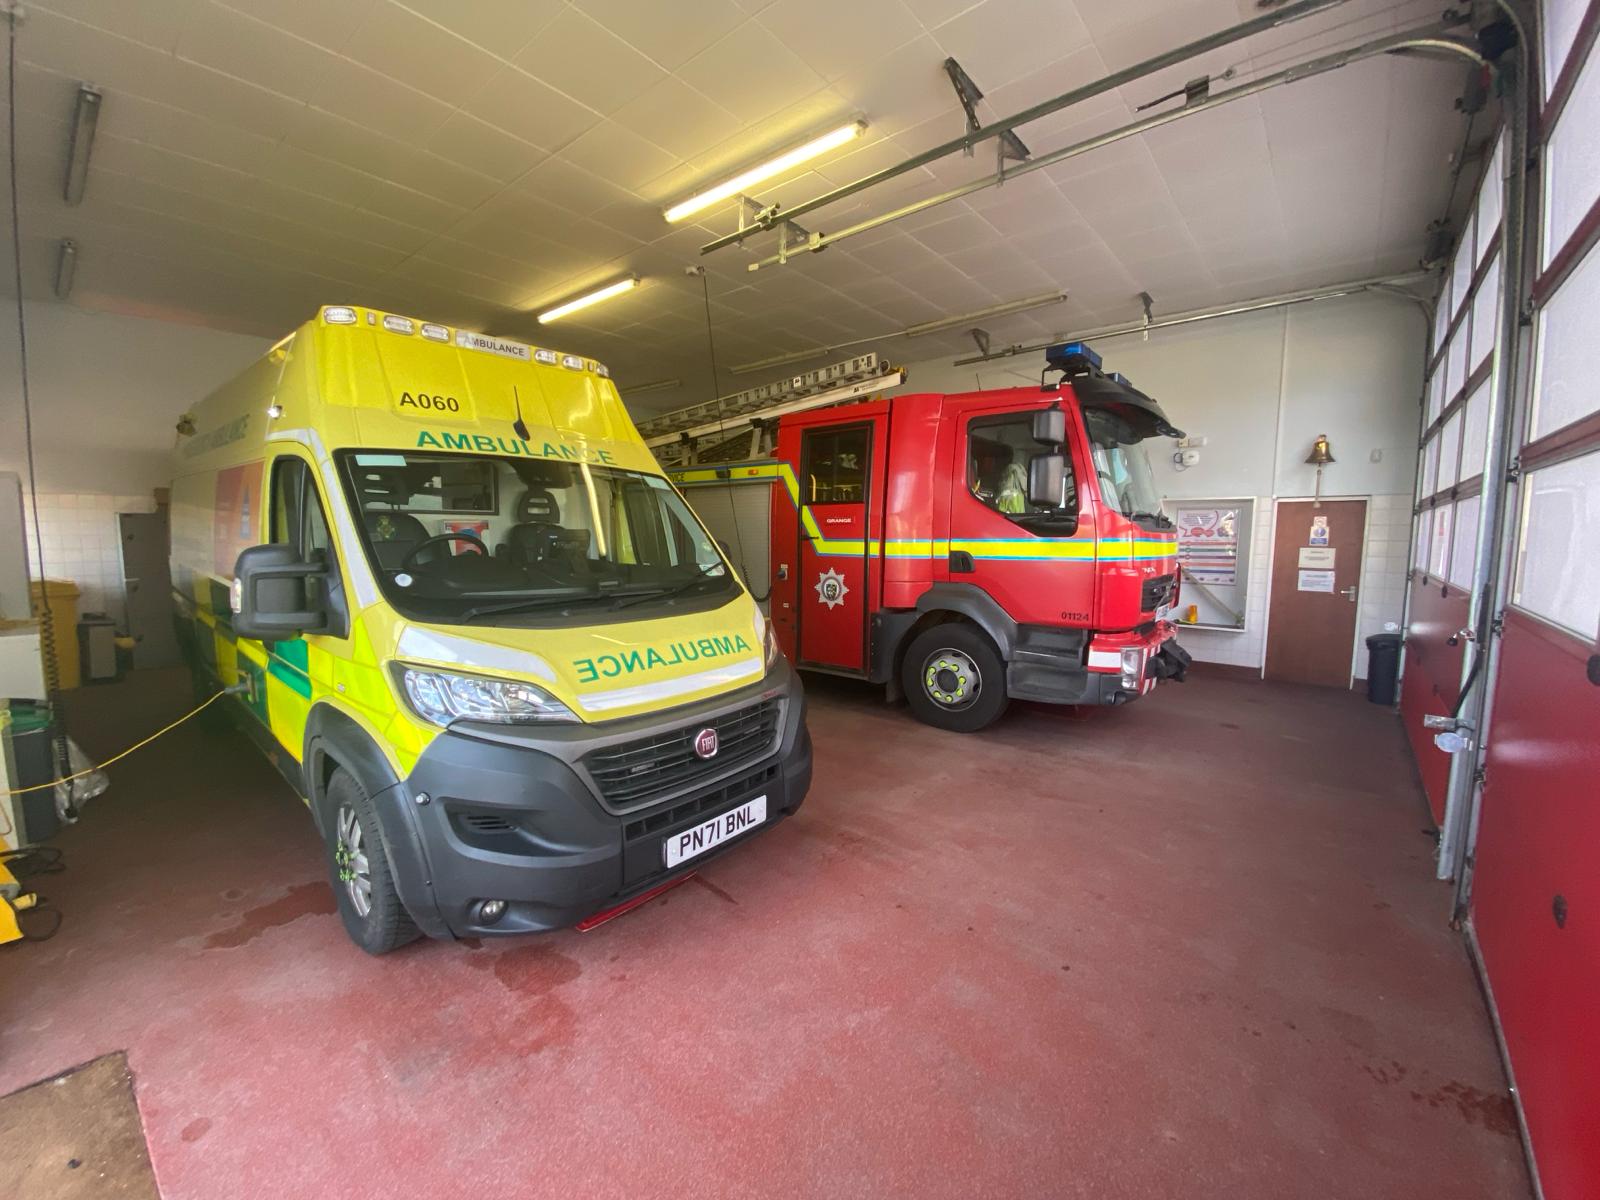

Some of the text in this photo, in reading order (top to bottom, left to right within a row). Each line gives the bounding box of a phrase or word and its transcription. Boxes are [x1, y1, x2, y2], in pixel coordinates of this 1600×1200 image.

[464, 333, 525, 356] AMBULANCE
[400, 392, 459, 412] A060
[1061, 611, 1090, 622] 01124
[701, 735, 715, 752] FIAT
[680, 806, 756, 857] PN71 BNL
